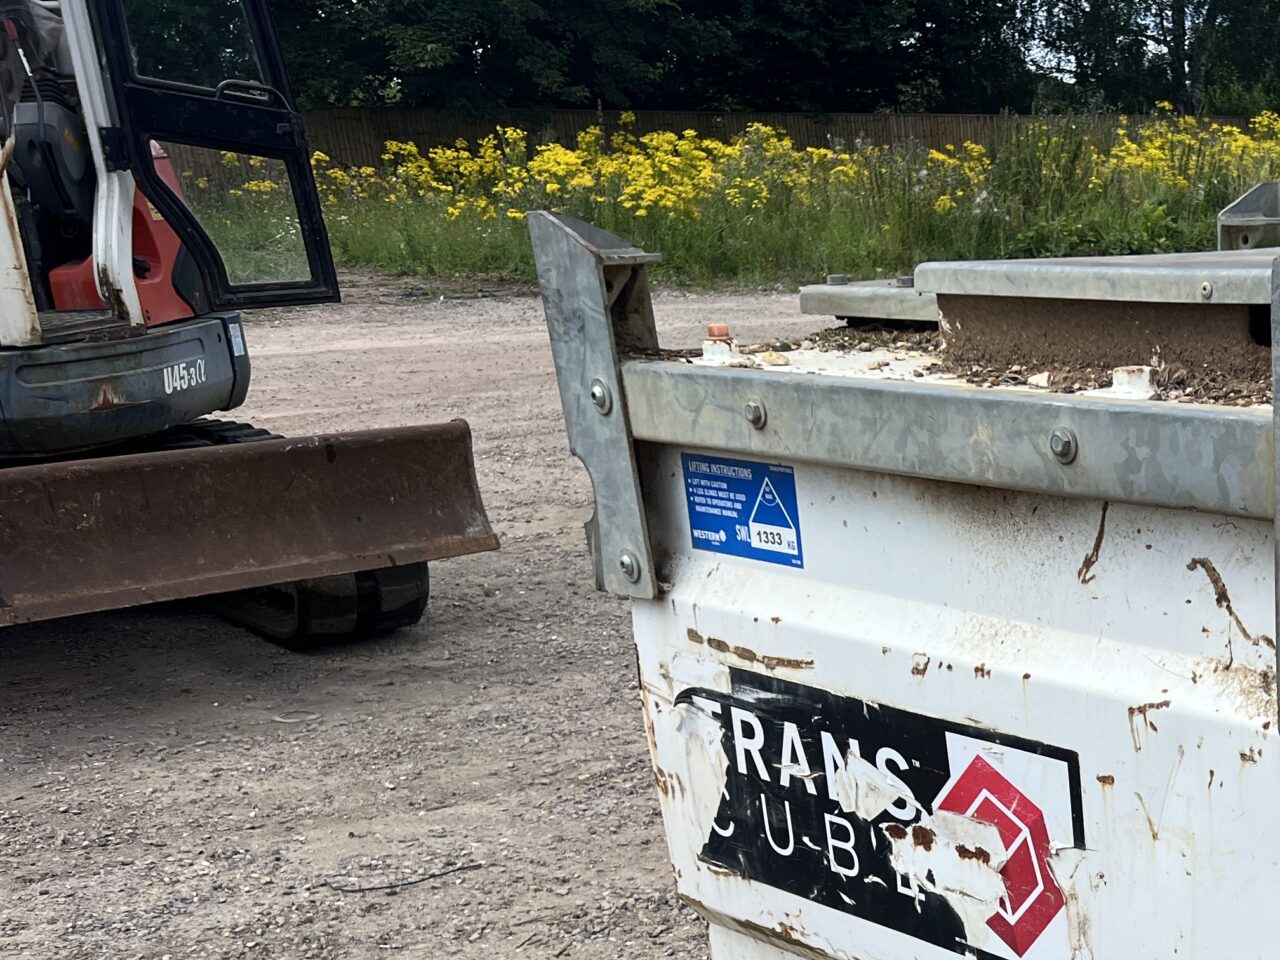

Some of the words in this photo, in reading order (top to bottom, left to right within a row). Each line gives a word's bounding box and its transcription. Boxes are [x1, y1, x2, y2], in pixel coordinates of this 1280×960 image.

[688, 461, 709, 472] LIFTING
[710, 463, 752, 478] INSTRUCTIONS
[692, 529, 720, 541] WESTERN
[735, 524, 751, 542] SWL
[757, 530, 782, 546] 1333
[787, 540, 796, 551] KG
